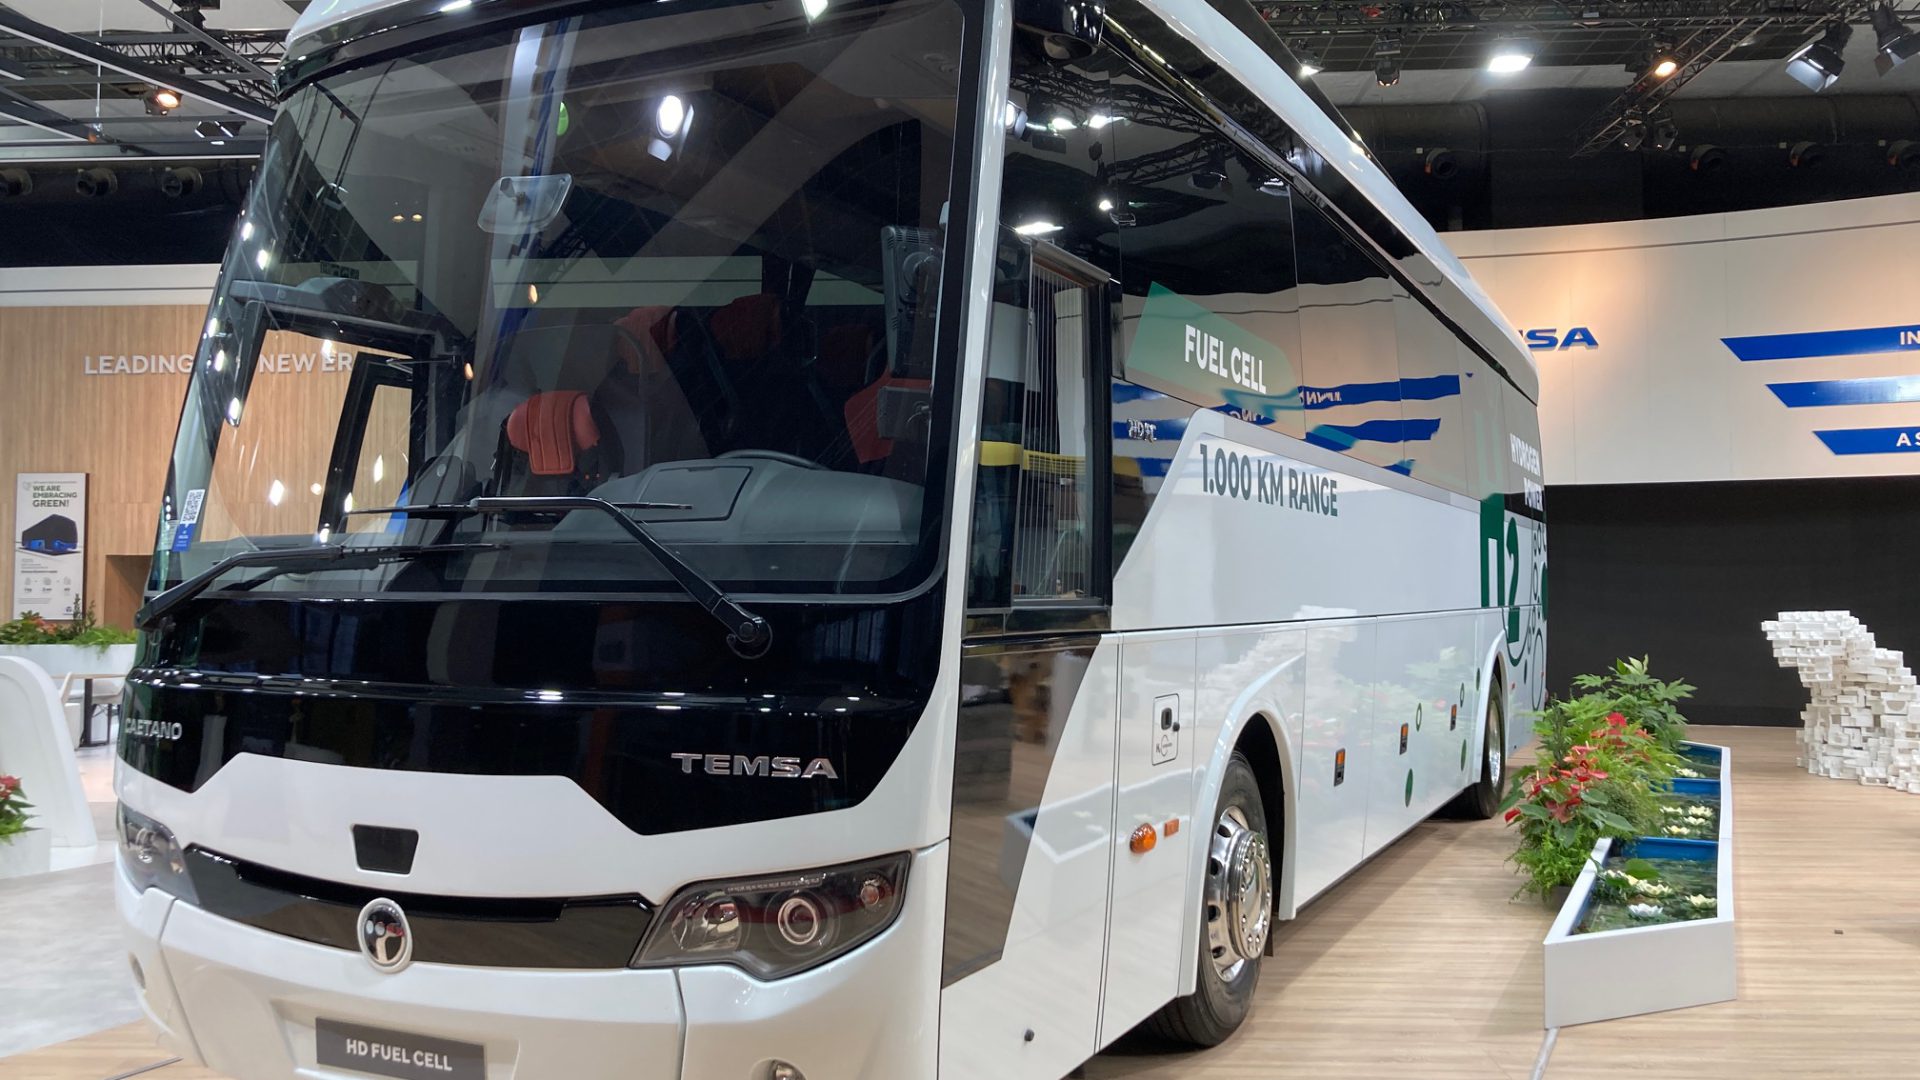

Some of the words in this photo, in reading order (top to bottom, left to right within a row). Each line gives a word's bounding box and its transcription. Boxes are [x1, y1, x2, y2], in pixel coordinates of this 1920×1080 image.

[1519, 327, 1599, 350] SA
[84, 354, 193, 375] LEADING
[259, 353, 316, 374] NEW
[321, 352, 352, 373] ER
[1185, 324, 1228, 378] FUEL
[1231, 347, 1267, 394] CELL
[1200, 444, 1252, 501] 1.000
[1257, 459, 1284, 507] KM
[1289, 468, 1338, 517] RANGE
[671, 753, 839, 779] TEMSA
[346, 1039, 368, 1056] HD
[371, 1044, 411, 1064] FUEL
[413, 1051, 453, 1071] CELL
